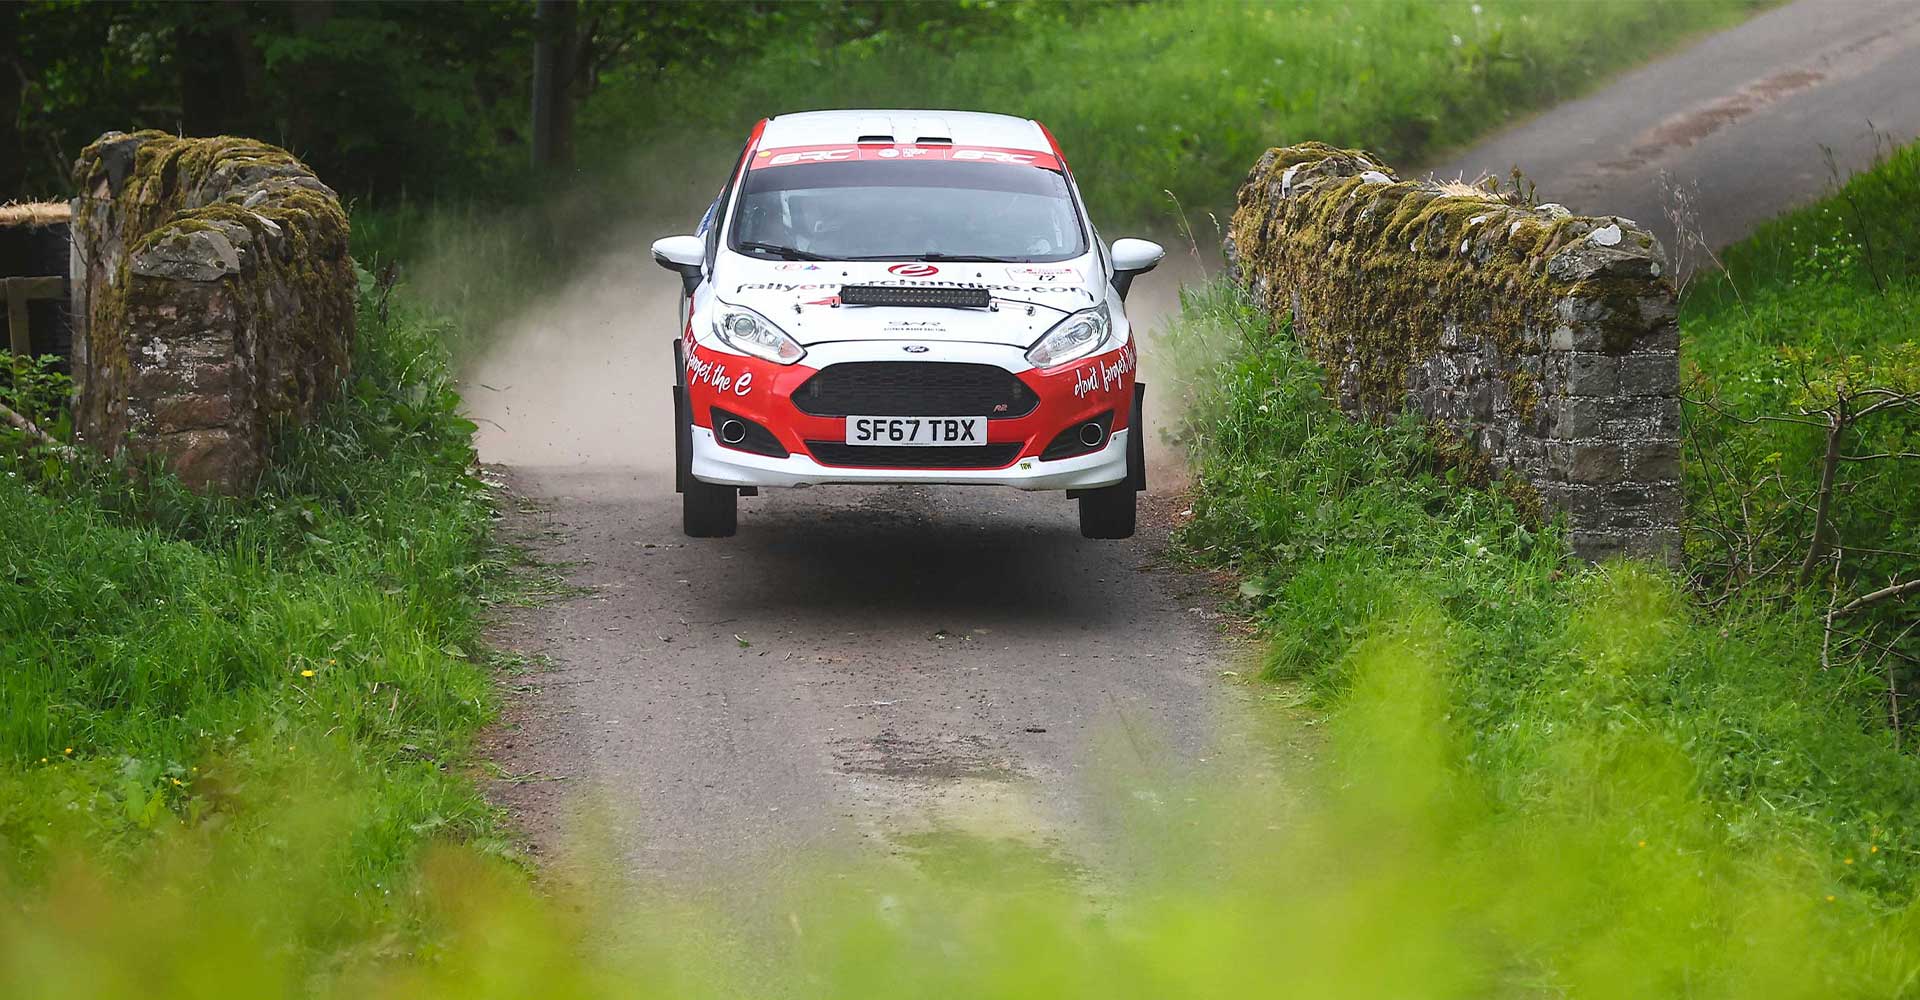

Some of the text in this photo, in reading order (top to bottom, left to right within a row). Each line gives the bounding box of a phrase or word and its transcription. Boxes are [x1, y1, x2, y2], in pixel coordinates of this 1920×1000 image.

[712, 364, 731, 394] the
[734, 372, 752, 396] e
[856, 419, 975, 442] SF67 TBX
